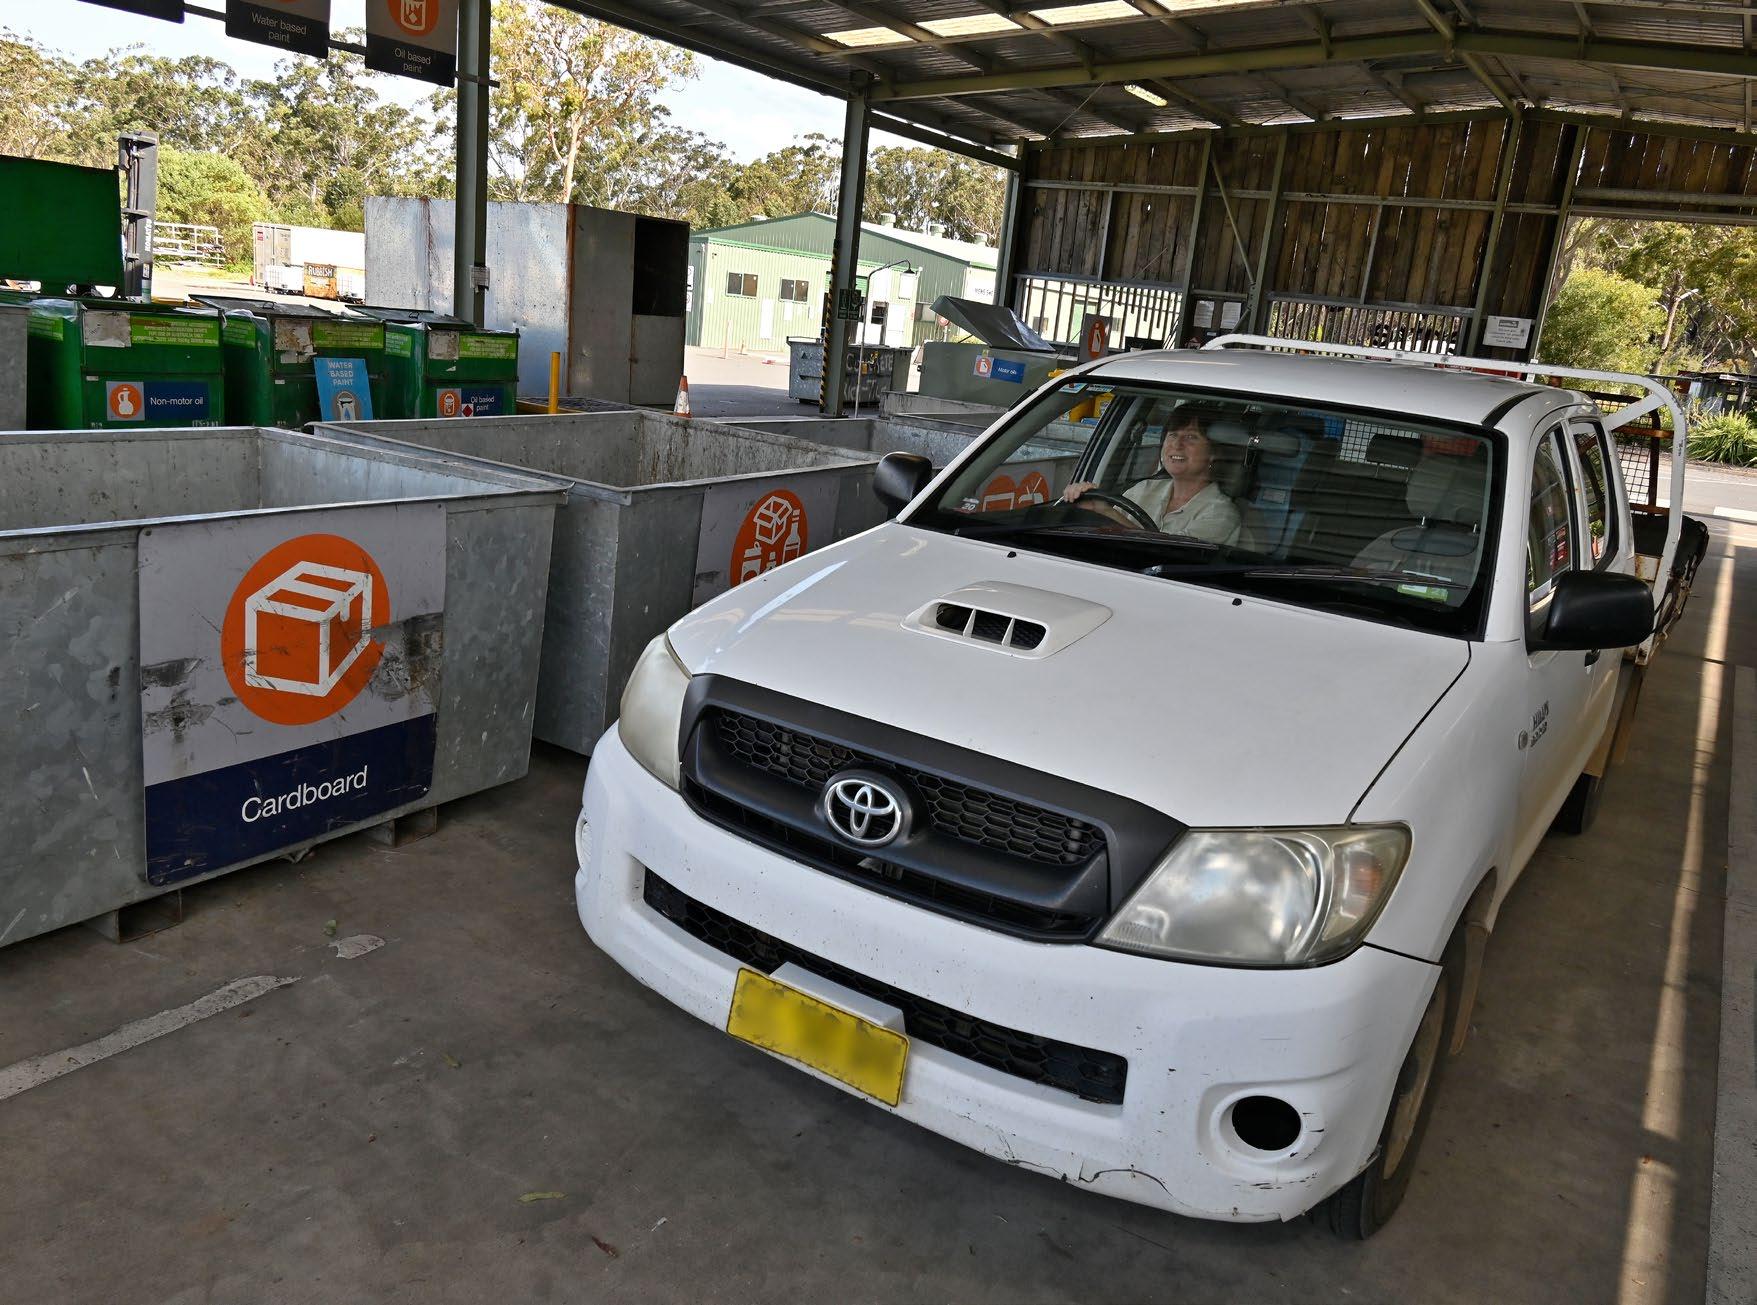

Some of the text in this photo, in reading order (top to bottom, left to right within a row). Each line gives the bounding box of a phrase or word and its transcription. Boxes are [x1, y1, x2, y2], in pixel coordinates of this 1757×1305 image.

[251, 12, 307, 35] Water based
[268, 31, 290, 43] paint
[394, 48, 431, 65] Oil based
[403, 63, 423, 74] paint
[308, 265, 333, 277] RUBBISH
[327, 361, 353, 369] WATER
[150, 397, 203, 405] Non-motor oil
[961, 503, 976, 511] 20
[241, 765, 368, 823] Cardboard
